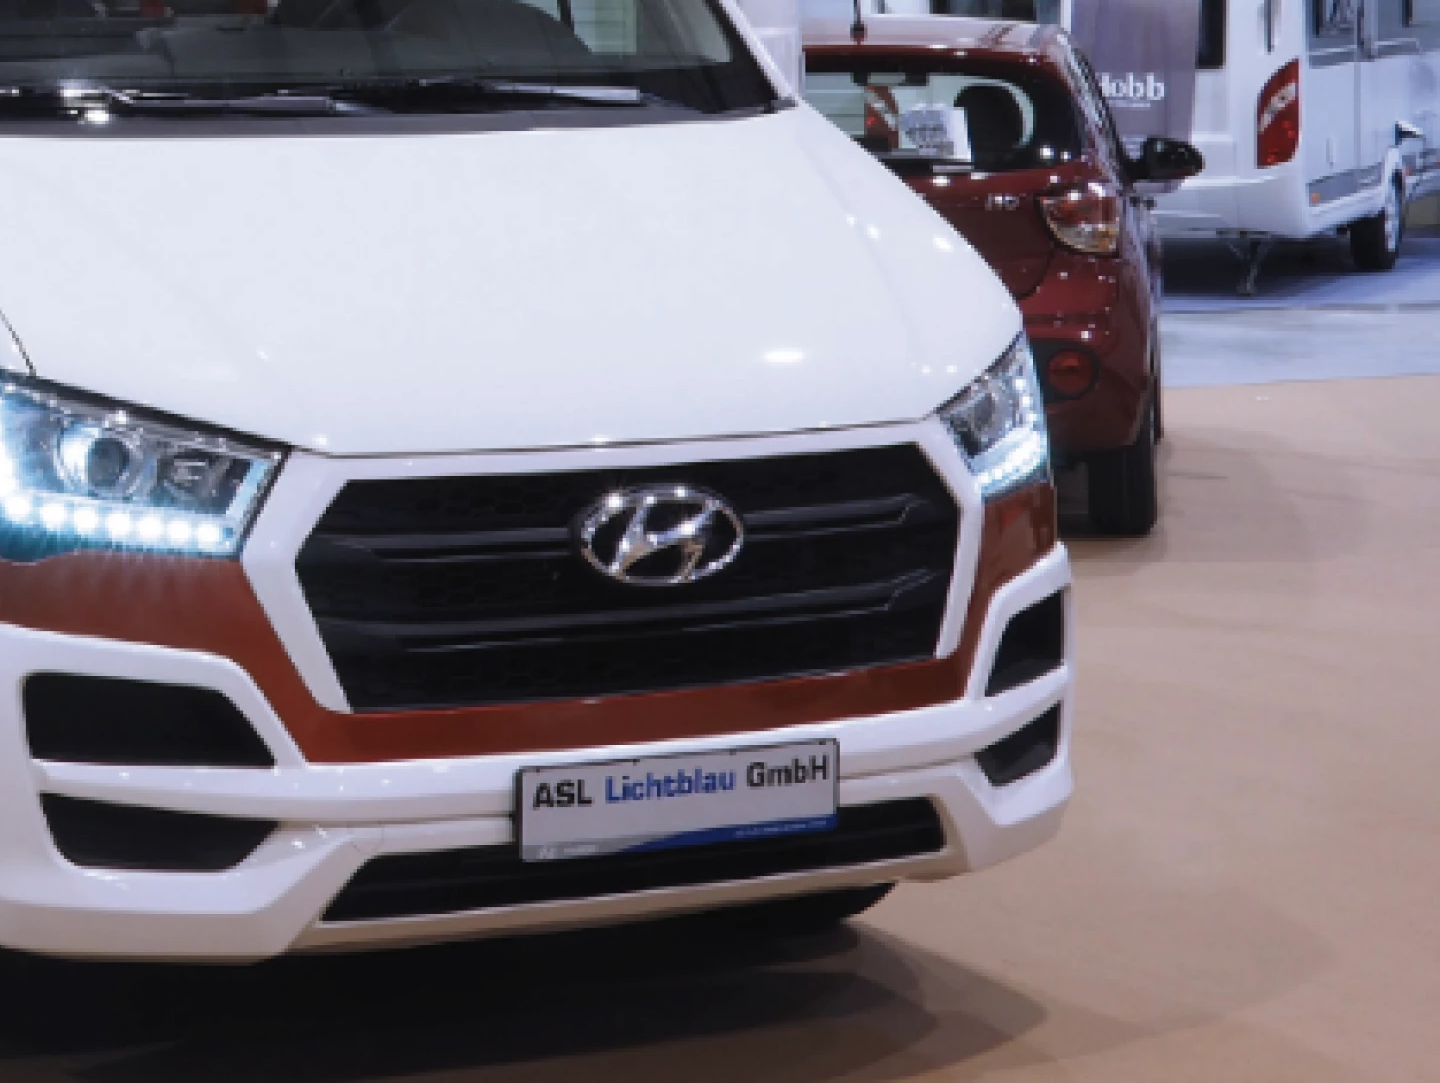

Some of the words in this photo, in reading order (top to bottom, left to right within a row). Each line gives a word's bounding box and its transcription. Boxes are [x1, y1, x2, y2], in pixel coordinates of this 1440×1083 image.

[533, 779, 594, 810] ASL
[605, 766, 737, 804] Lichtblau
[746, 755, 830, 787] GmbH
